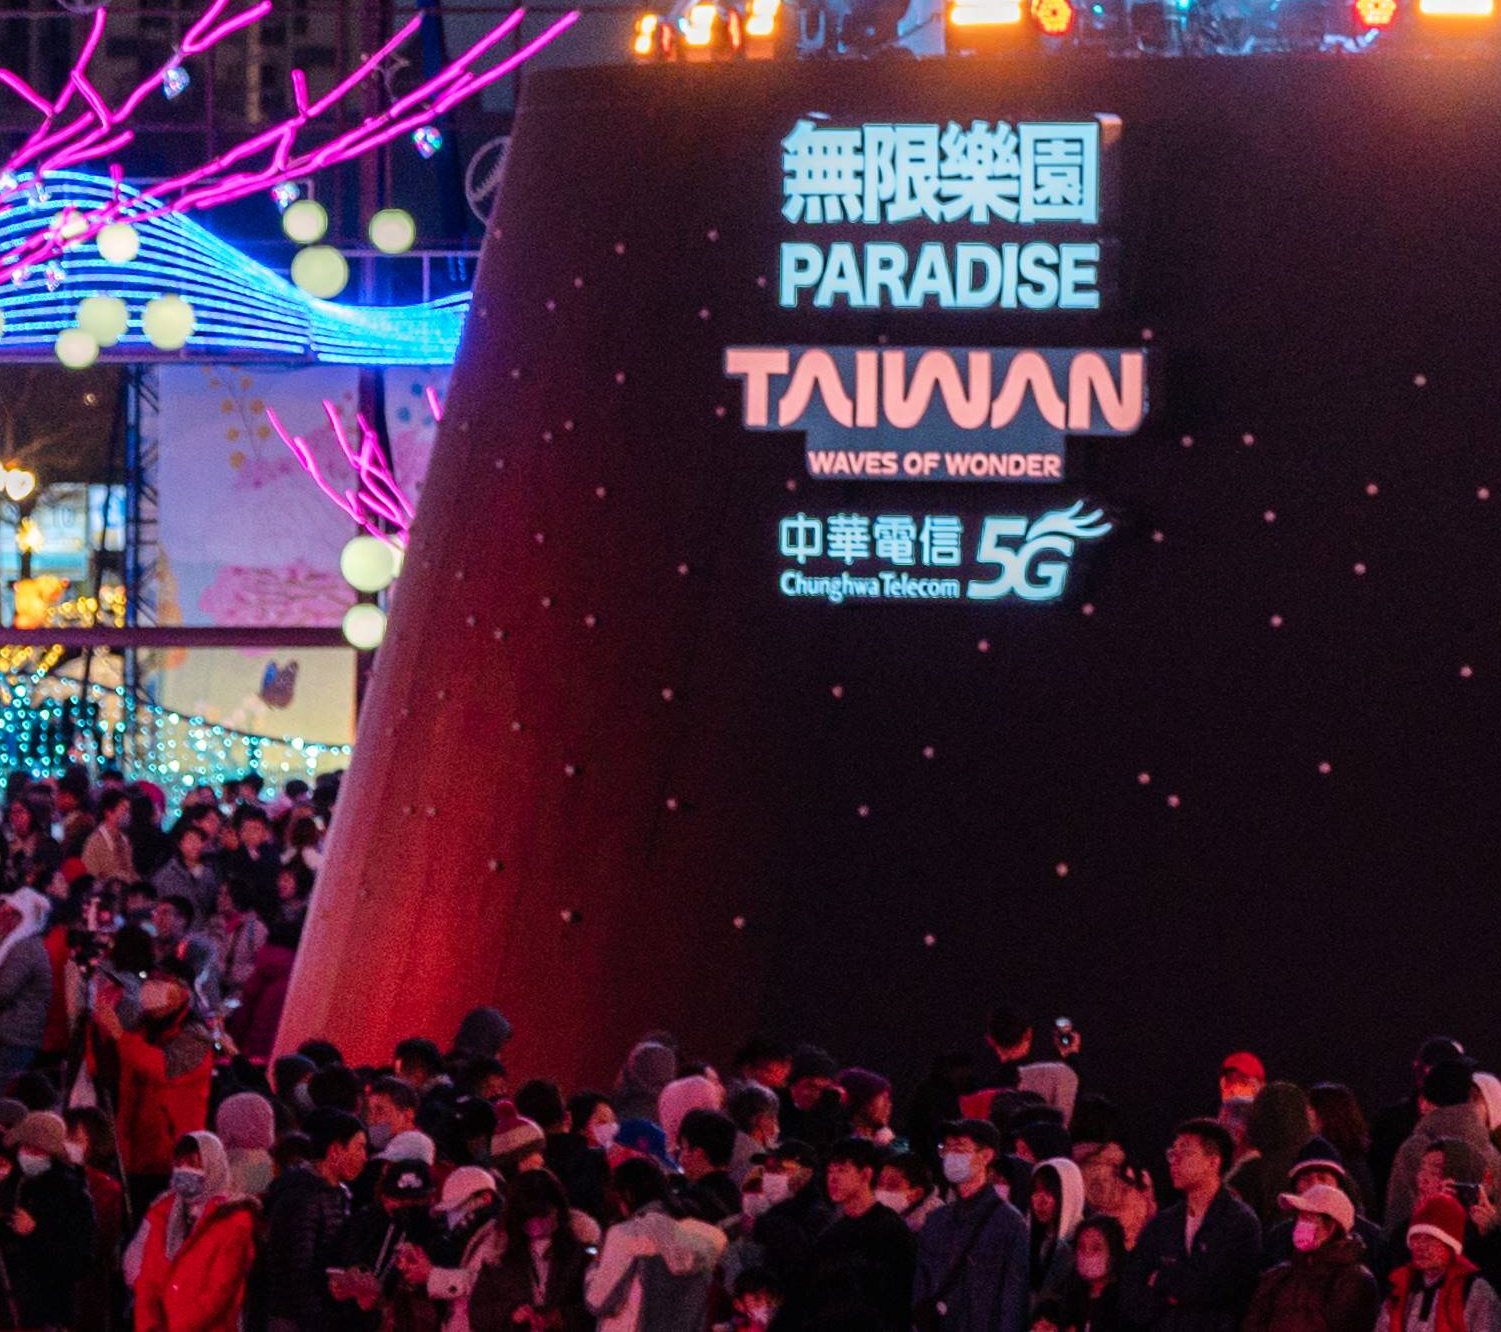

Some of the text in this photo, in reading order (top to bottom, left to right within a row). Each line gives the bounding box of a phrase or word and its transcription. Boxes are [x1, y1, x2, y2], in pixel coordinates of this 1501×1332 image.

[780, 120, 1100, 225] 無限樂園
[779, 241, 1100, 310] PARADISE
[726, 348, 1143, 431] TAIWAN
[808, 451, 1062, 477] WAVES OF WONDER
[779, 512, 962, 566] 中華電信
[967, 510, 1084, 602] 5G
[779, 570, 961, 604] Chunghwa Telecom
